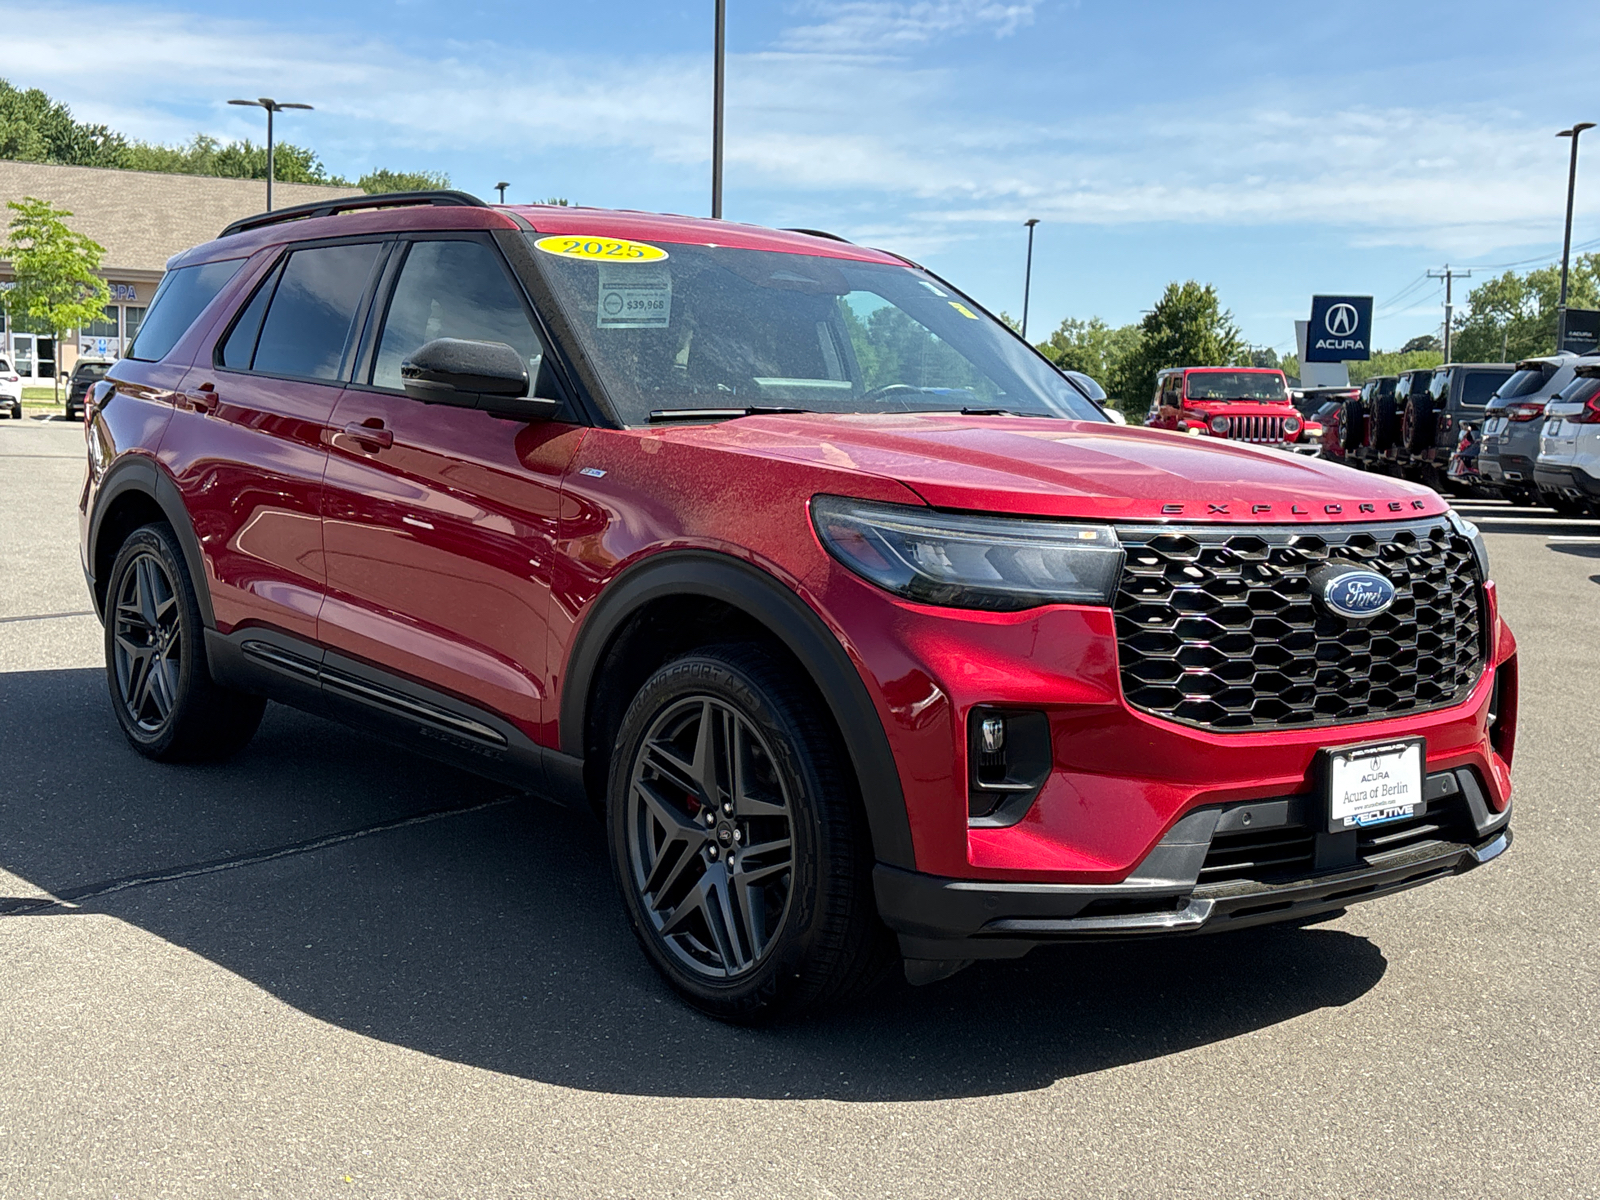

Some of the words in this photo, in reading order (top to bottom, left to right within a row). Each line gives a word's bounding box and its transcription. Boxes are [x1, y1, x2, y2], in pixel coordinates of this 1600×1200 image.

[562, 240, 645, 258] 2025
[627, 300, 664, 311] $39,968
[1315, 338, 1365, 350] ACURA
[1160, 499, 1426, 515] EXPLORER
[1345, 580, 1384, 608] Ford
[671, 663, 722, 682] SPORT
[1360, 771, 1390, 783] ACURA
[1343, 790, 1368, 805] Acura
[1369, 786, 1379, 799] of
[1381, 781, 1409, 797] Berlin
[1343, 805, 1413, 827] EXECUTIVE
